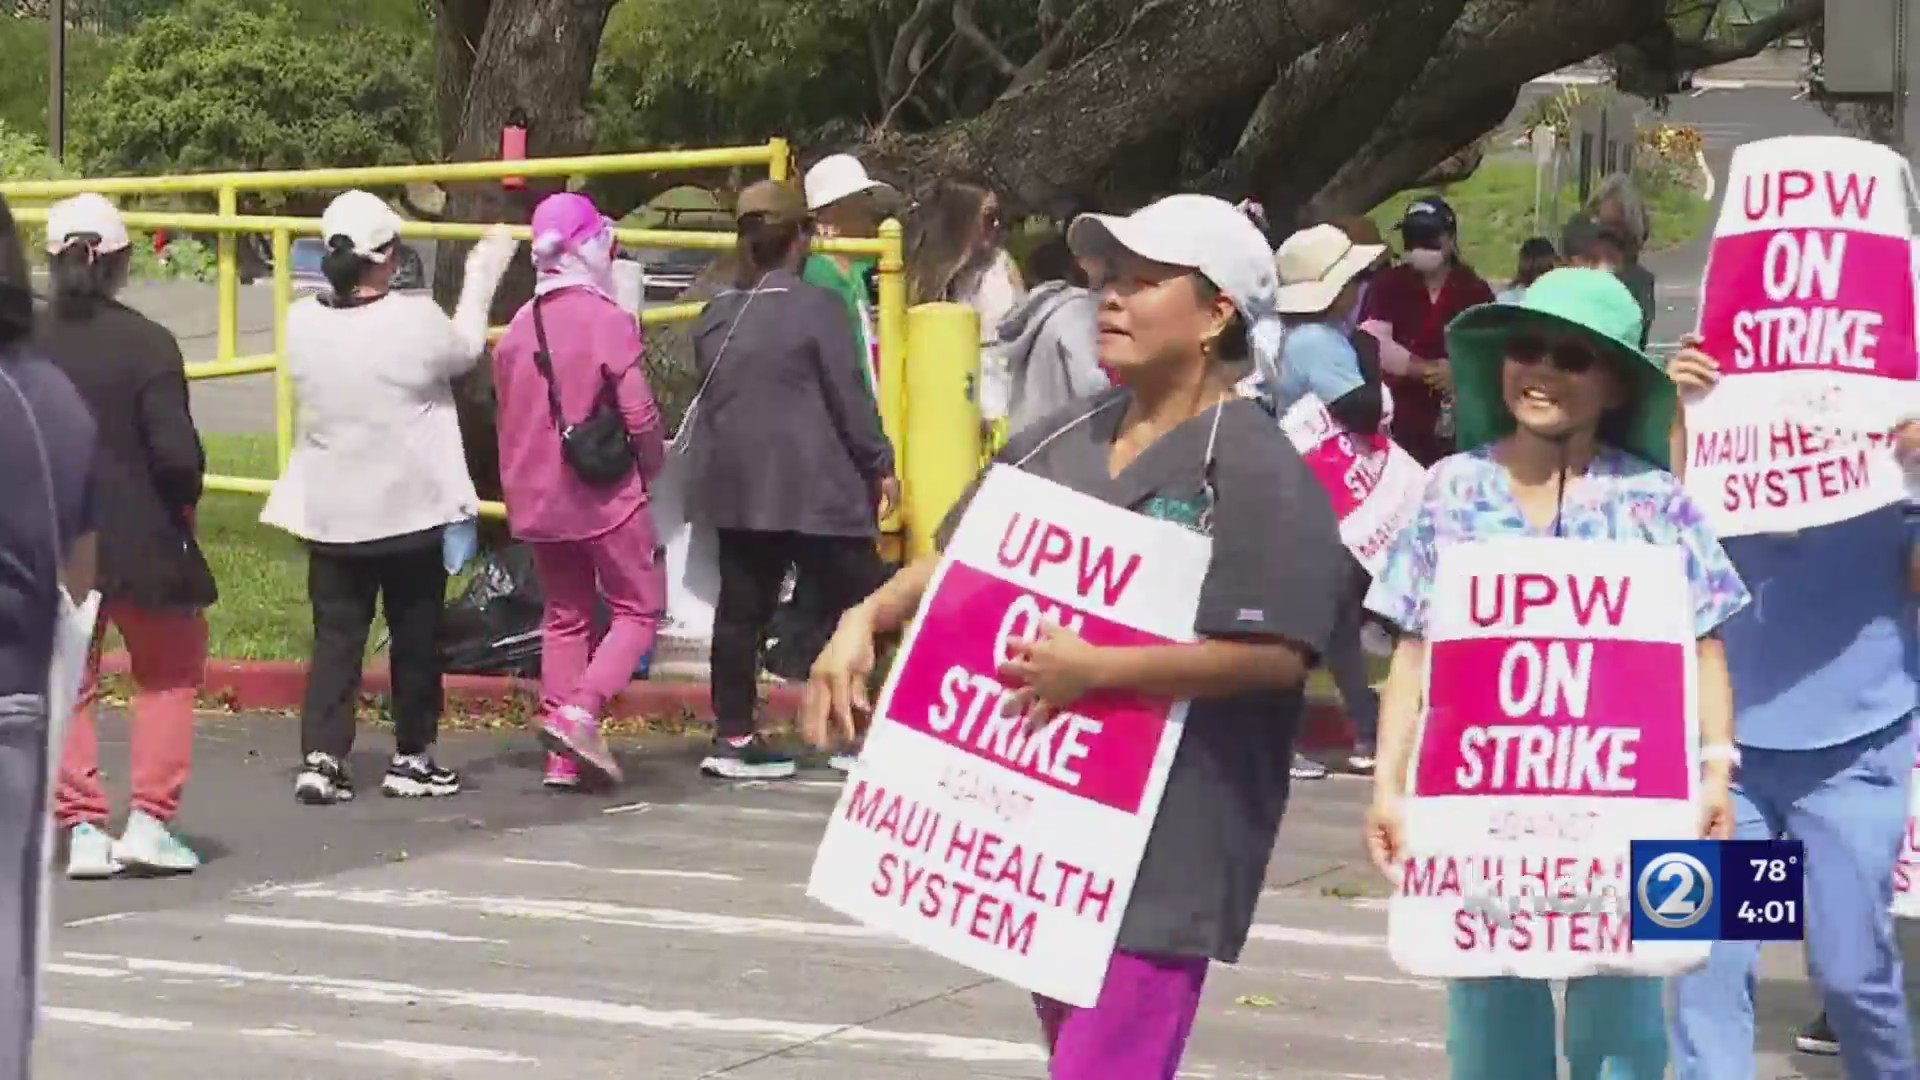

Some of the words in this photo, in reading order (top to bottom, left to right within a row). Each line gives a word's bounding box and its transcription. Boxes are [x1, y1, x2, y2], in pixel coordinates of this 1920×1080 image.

[1743, 169, 1878, 221] UPW
[1762, 230, 1847, 301] ON
[1732, 306, 1883, 370] STRIKE
[1694, 424, 1759, 468] MAUI
[1723, 450, 1871, 512] SYSTEM
[997, 511, 1142, 607] UPW
[1468, 573, 1632, 628] UPW
[1498, 641, 1595, 719] ON
[1455, 725, 1641, 791] STRIKE
[845, 780, 938, 854] MAUI
[944, 820, 1116, 923] HEALTH
[871, 853, 1039, 957] SYSTEM
[1452, 907, 1636, 953] SYSTEM
